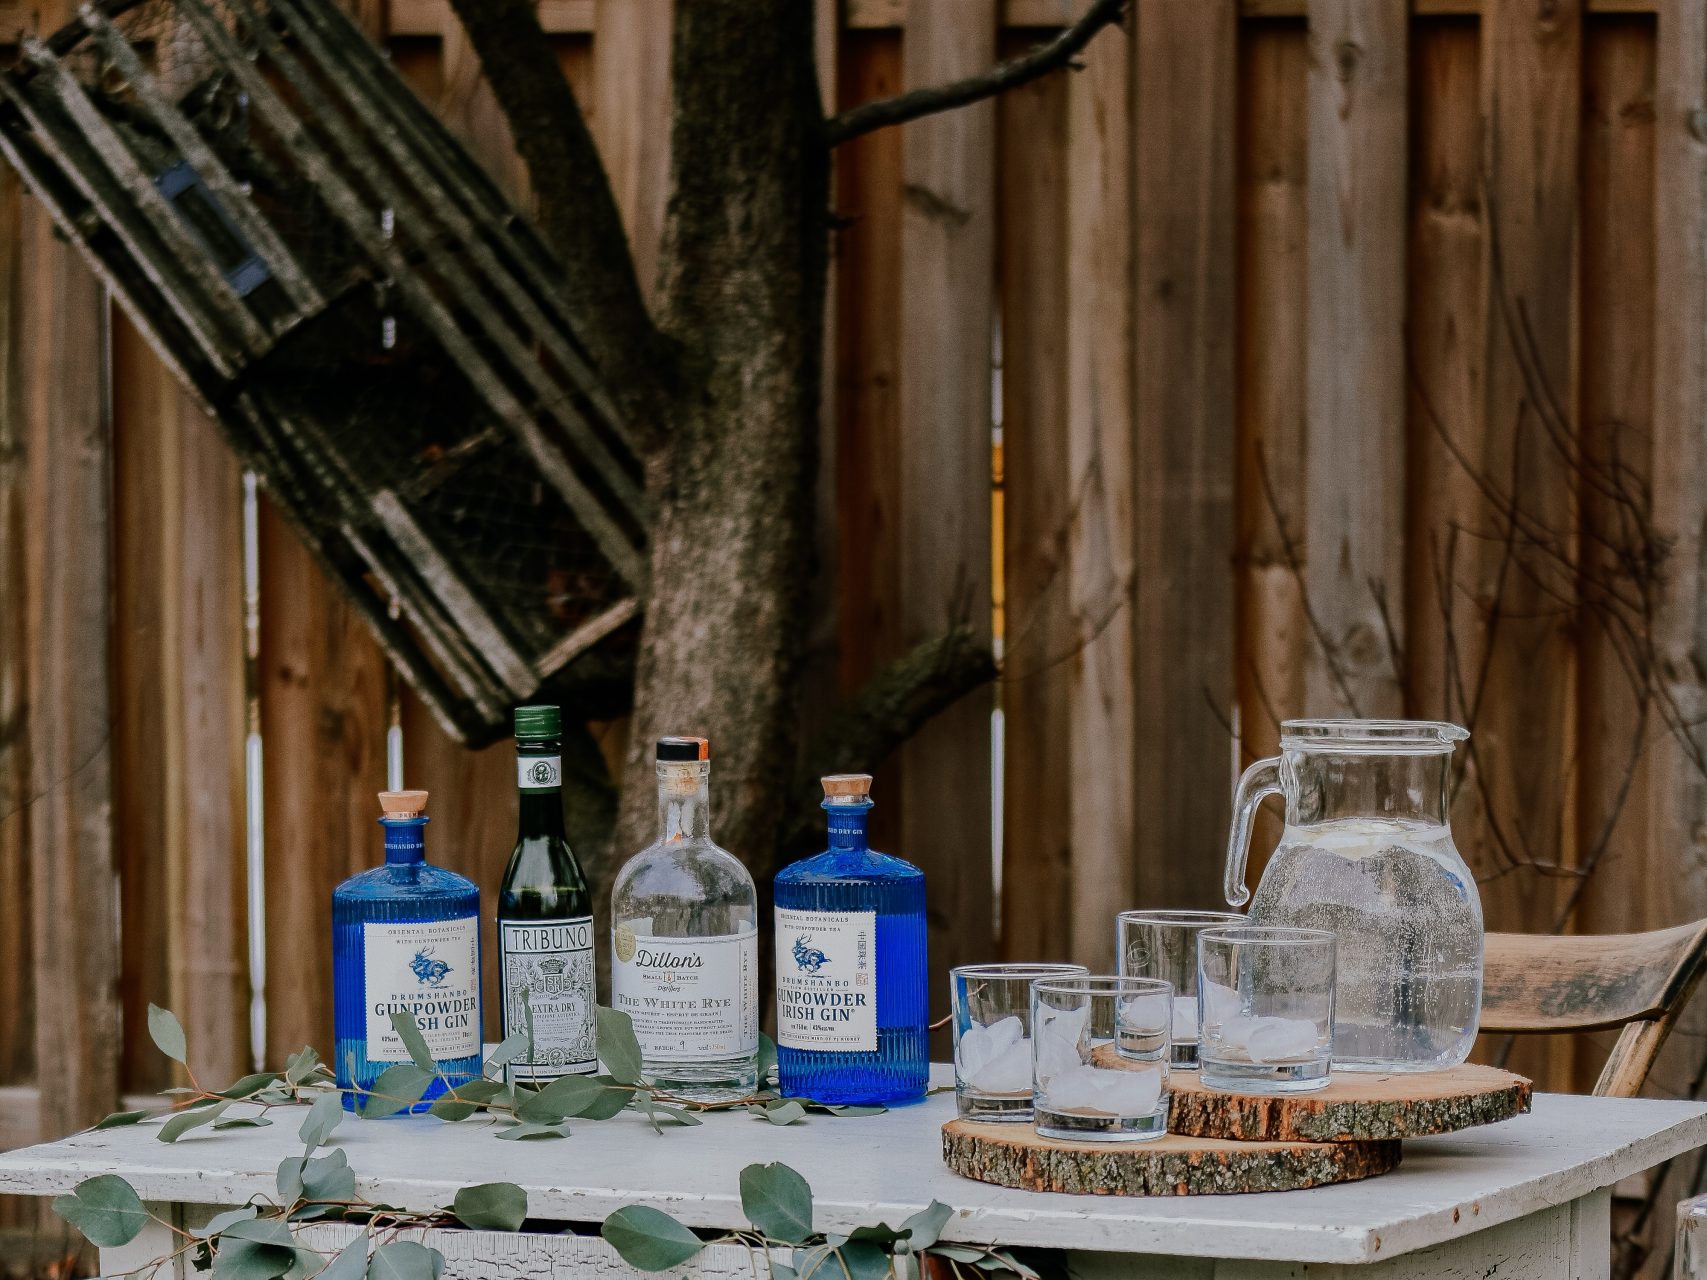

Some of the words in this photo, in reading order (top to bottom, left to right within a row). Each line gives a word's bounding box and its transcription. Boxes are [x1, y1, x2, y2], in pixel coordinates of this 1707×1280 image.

[512, 926, 587, 950] TRIBUNO
[636, 949, 704, 968] Dillon's
[782, 976, 849, 987] DRUMSHANBO
[391, 990, 468, 1001] DRUMSHANBO
[618, 993, 640, 1007] THE
[643, 997, 697, 1009] WHITE
[702, 998, 732, 1008] RYE
[778, 987, 867, 1007] GUNPOWDER
[374, 996, 477, 1017] GUNPOWDER
[532, 1004, 560, 1014] EXTRA
[561, 1002, 576, 1012] DRY
[782, 1004, 814, 1020] IRISH
[444, 1014, 468, 1029] GIN
